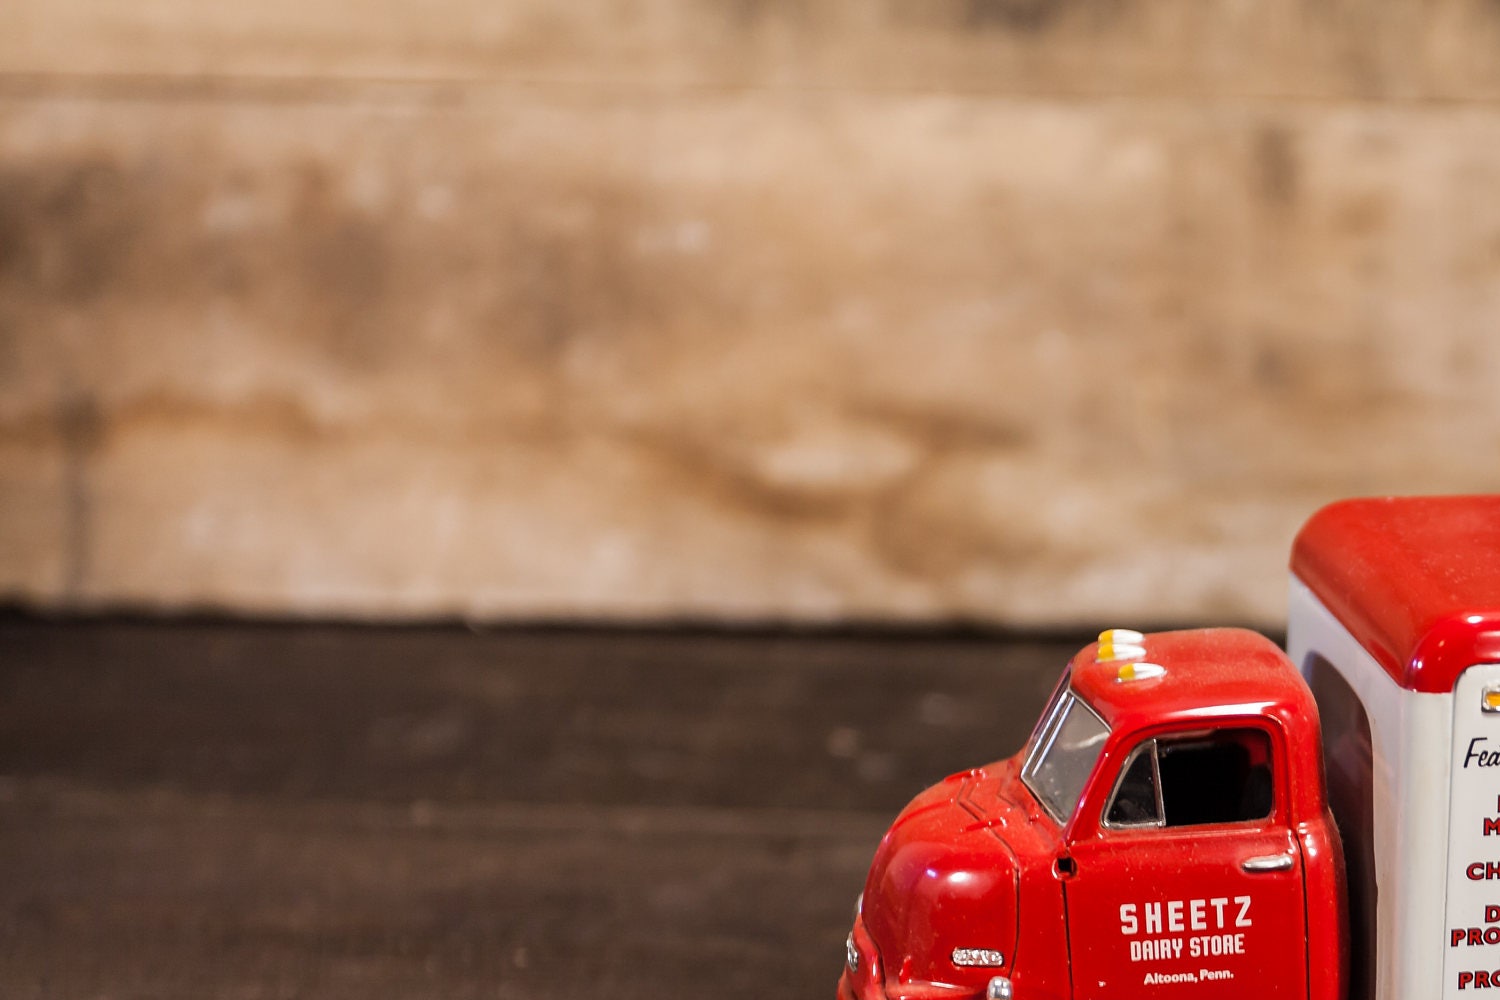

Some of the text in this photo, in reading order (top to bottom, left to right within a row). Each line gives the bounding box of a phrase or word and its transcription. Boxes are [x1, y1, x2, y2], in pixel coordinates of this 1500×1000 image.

[1119, 895, 1252, 935] SHEETZ
[1130, 933, 1246, 962] DAIRY STORE
[1143, 968, 1234, 985] Altoona, Penn.
